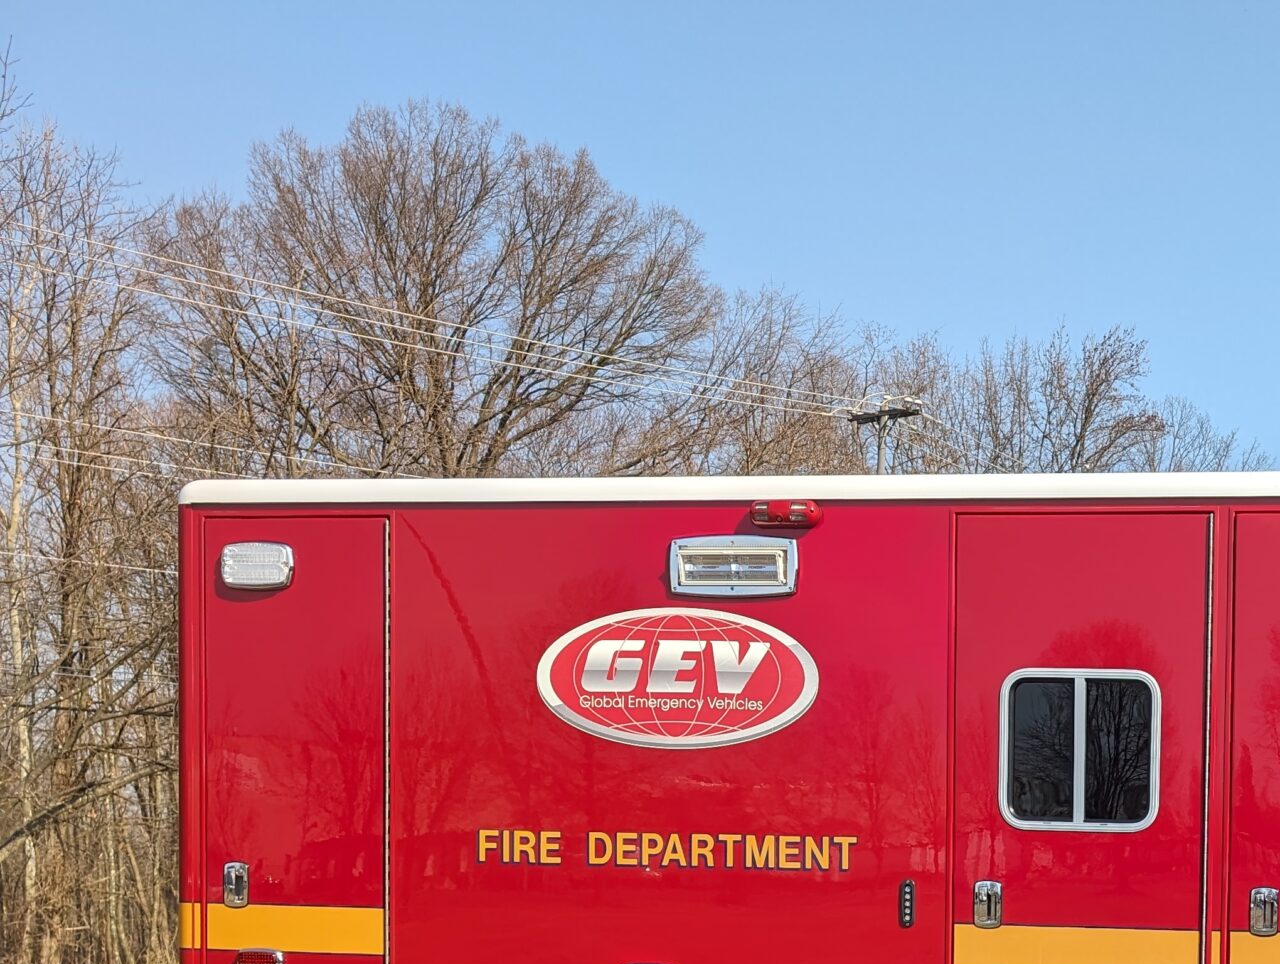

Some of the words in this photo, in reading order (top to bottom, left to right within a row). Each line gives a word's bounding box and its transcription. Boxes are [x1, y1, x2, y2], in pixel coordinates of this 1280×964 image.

[580, 639, 771, 694] GEV
[579, 695, 624, 709] Global
[628, 695, 703, 711] Emergency
[707, 696, 763, 711] Vehicles
[477, 829, 562, 864] FIRE
[587, 831, 858, 870] DEPARTMENT
